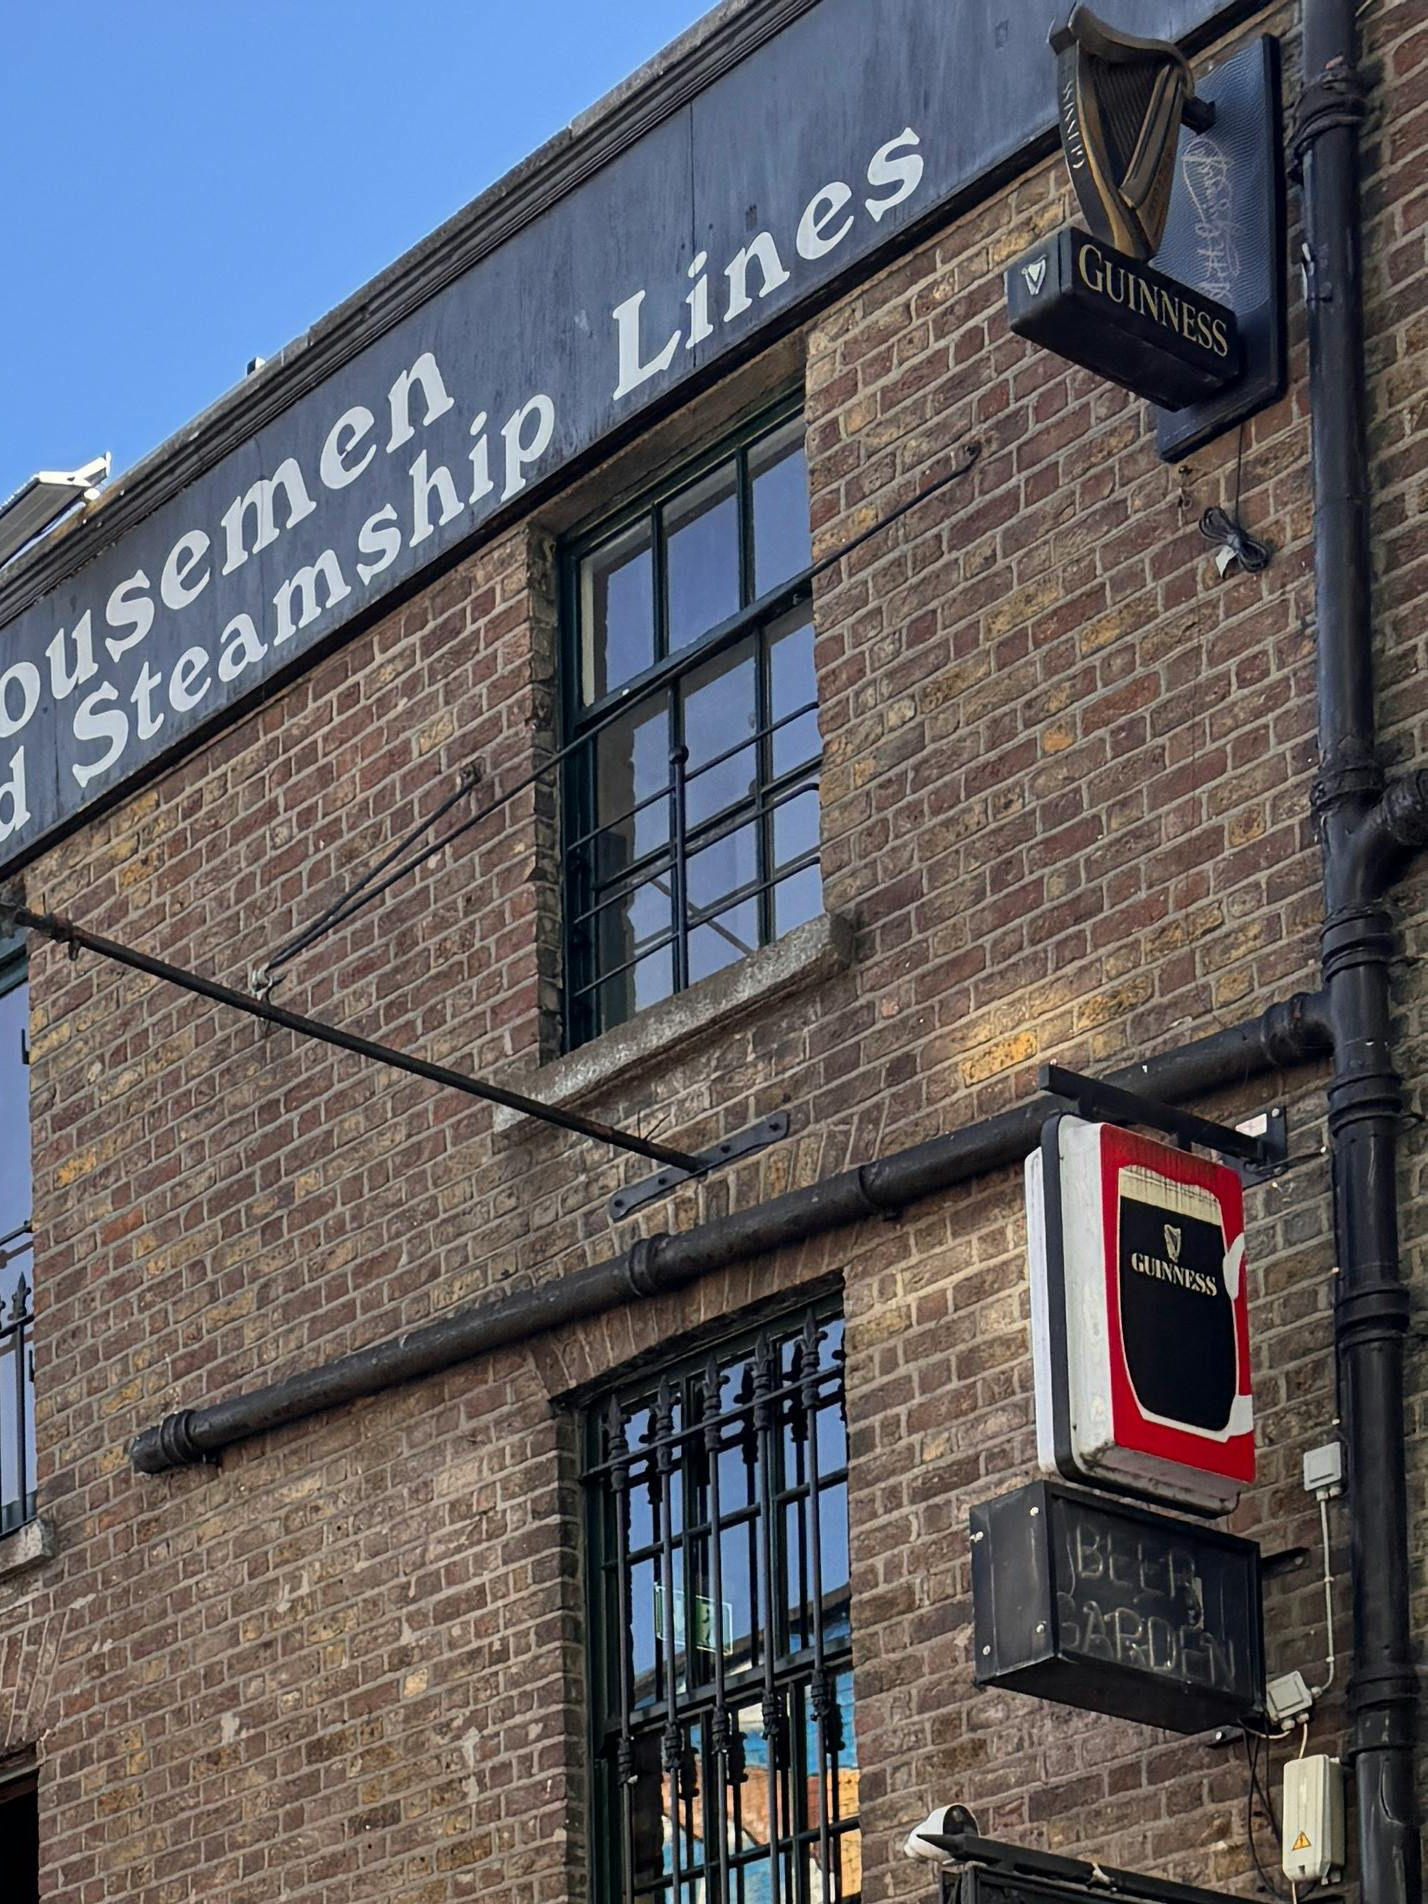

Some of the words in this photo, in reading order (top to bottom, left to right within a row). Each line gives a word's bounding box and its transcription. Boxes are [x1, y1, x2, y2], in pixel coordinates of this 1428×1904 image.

[1078, 243, 1229, 358] GUINNESS
[72, 393, 556, 790] Steamship
[611, 126, 926, 402] Lines
[1130, 1252, 1218, 1298] GUINNESS
